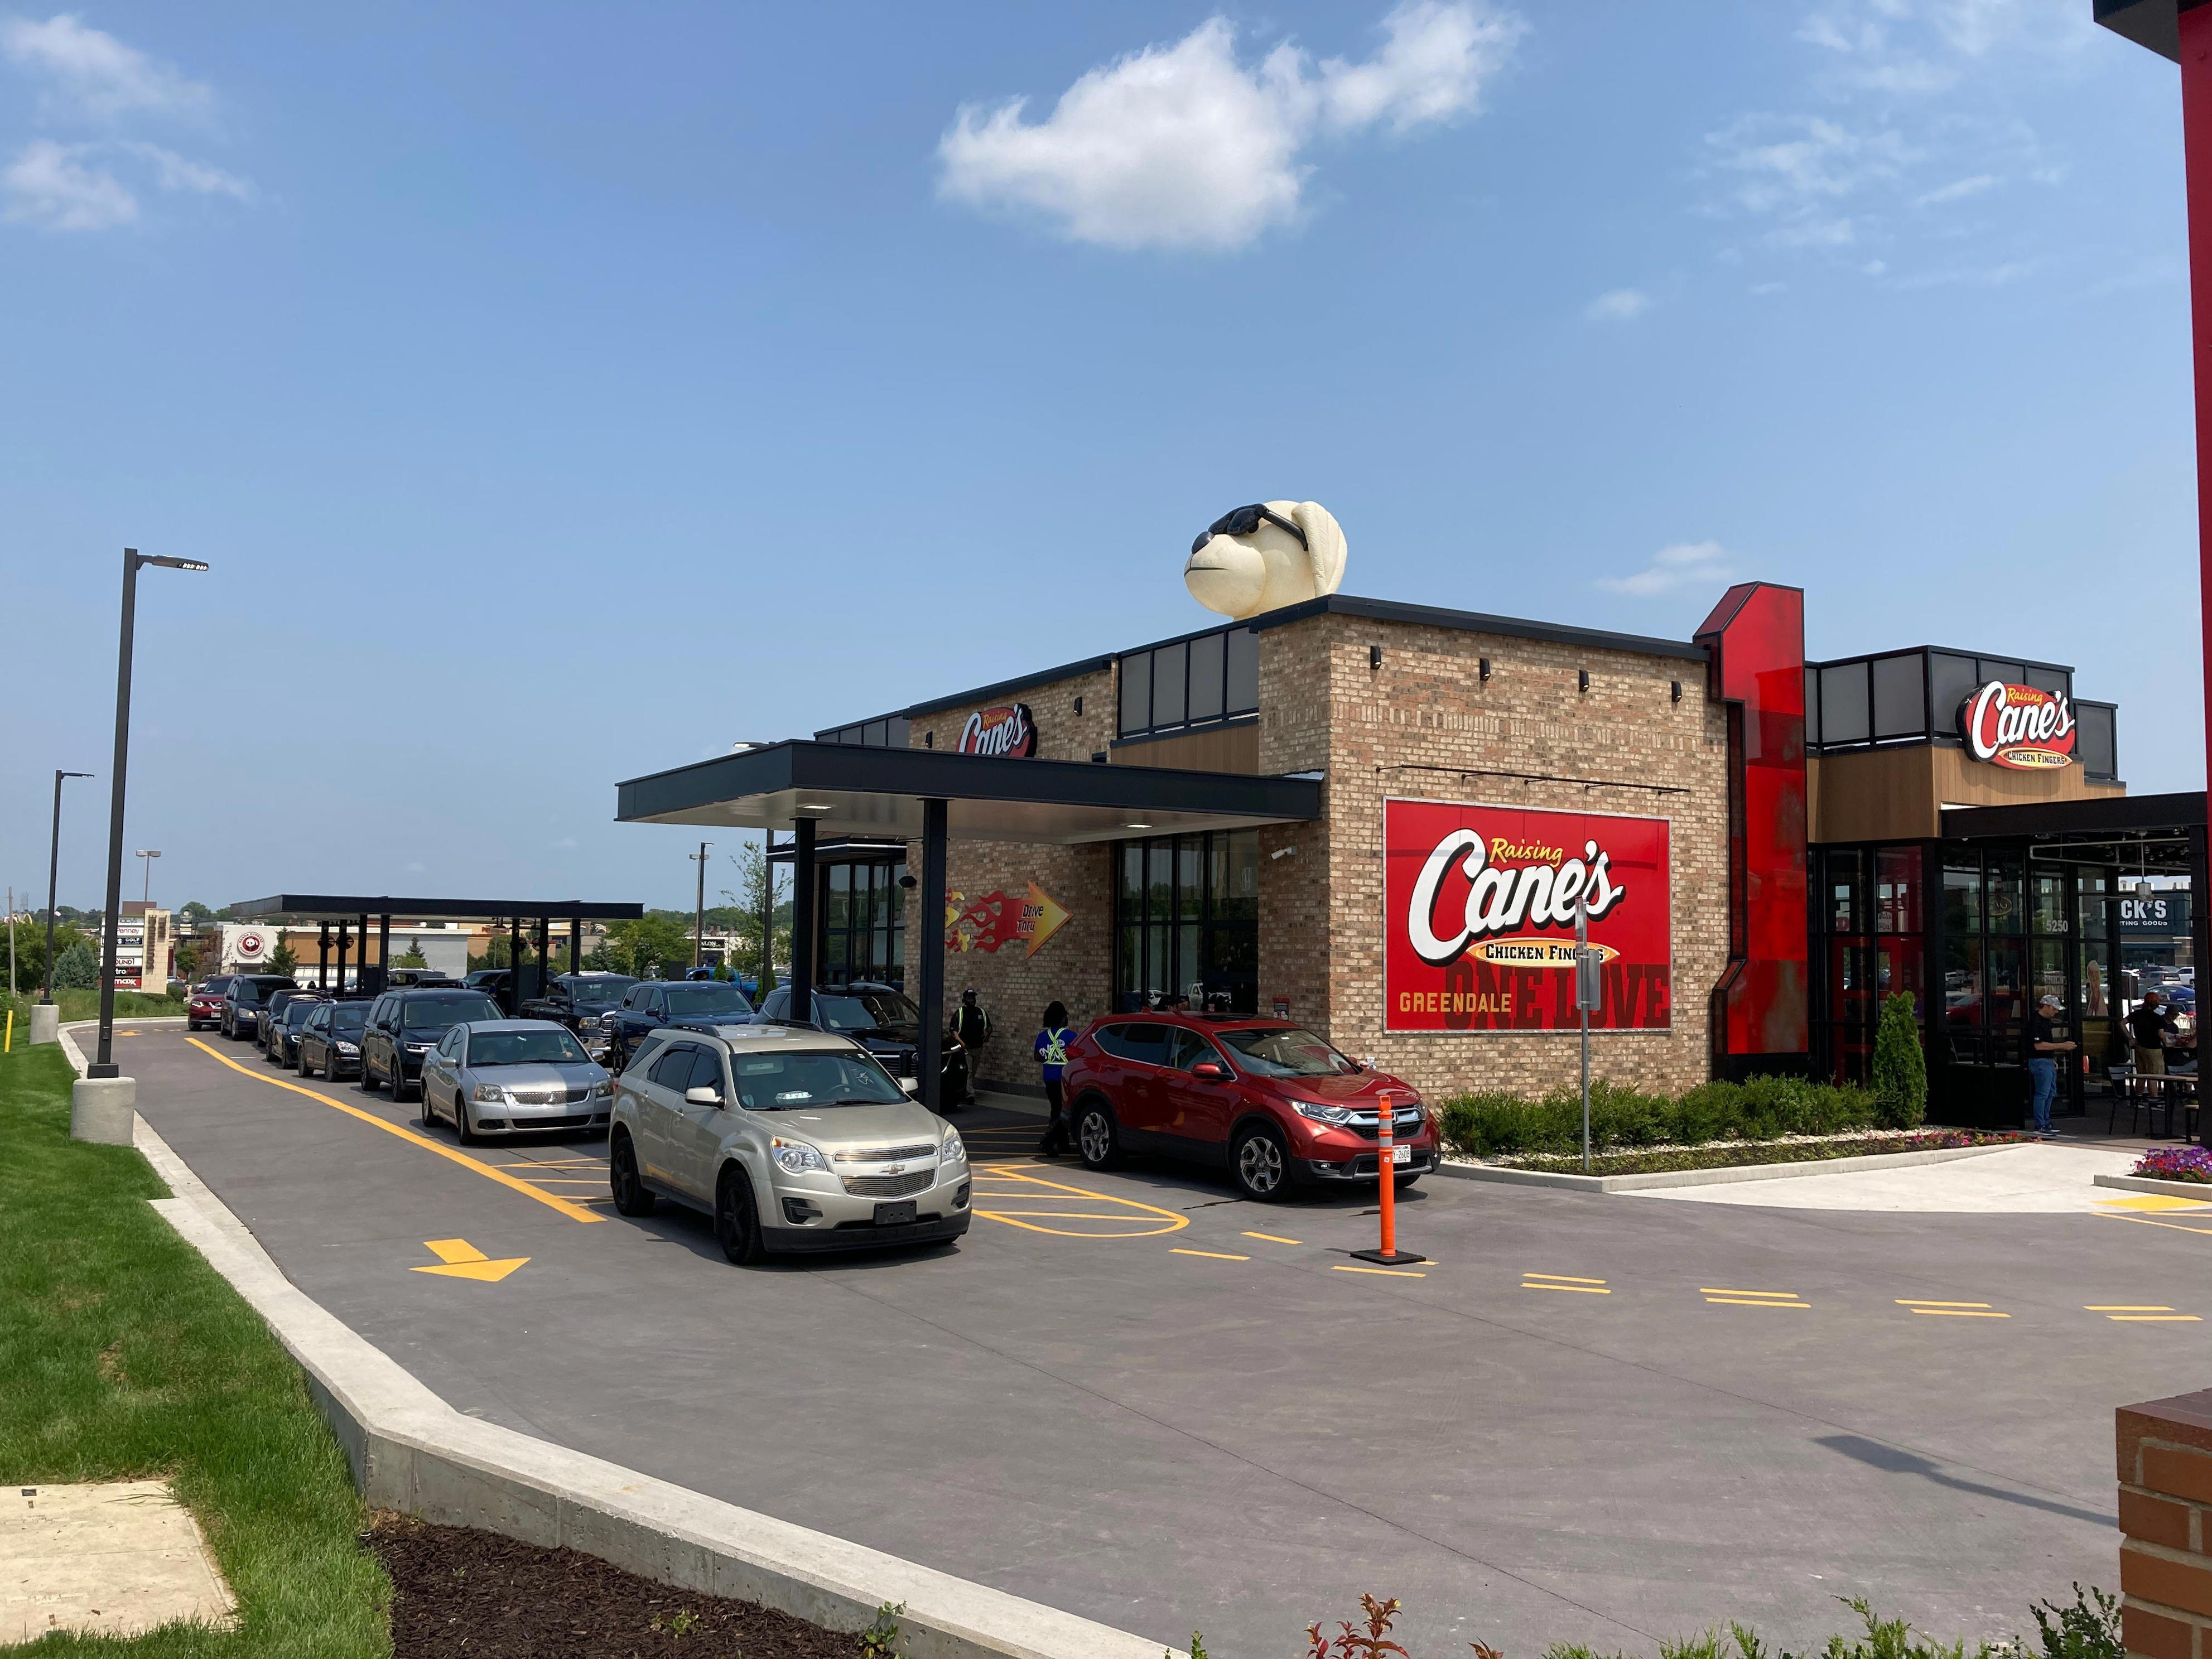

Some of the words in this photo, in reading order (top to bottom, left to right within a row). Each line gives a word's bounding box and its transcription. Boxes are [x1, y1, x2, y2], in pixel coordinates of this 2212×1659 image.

[2007, 687, 2043, 706] Raising
[983, 710, 1007, 727] Raising
[1972, 681, 2075, 759] Cane's
[1489, 838, 1563, 867] Raising
[1408, 828, 1624, 959] Cane's
[1022, 904, 1044, 918] Drive
[1016, 920, 1035, 932] Thru
[2046, 920, 2068, 932] 5250
[1486, 943, 1544, 960] CHICKEN
[1399, 992, 1512, 1013] GREENDALE
[1444, 961, 1543, 1030] ONE
